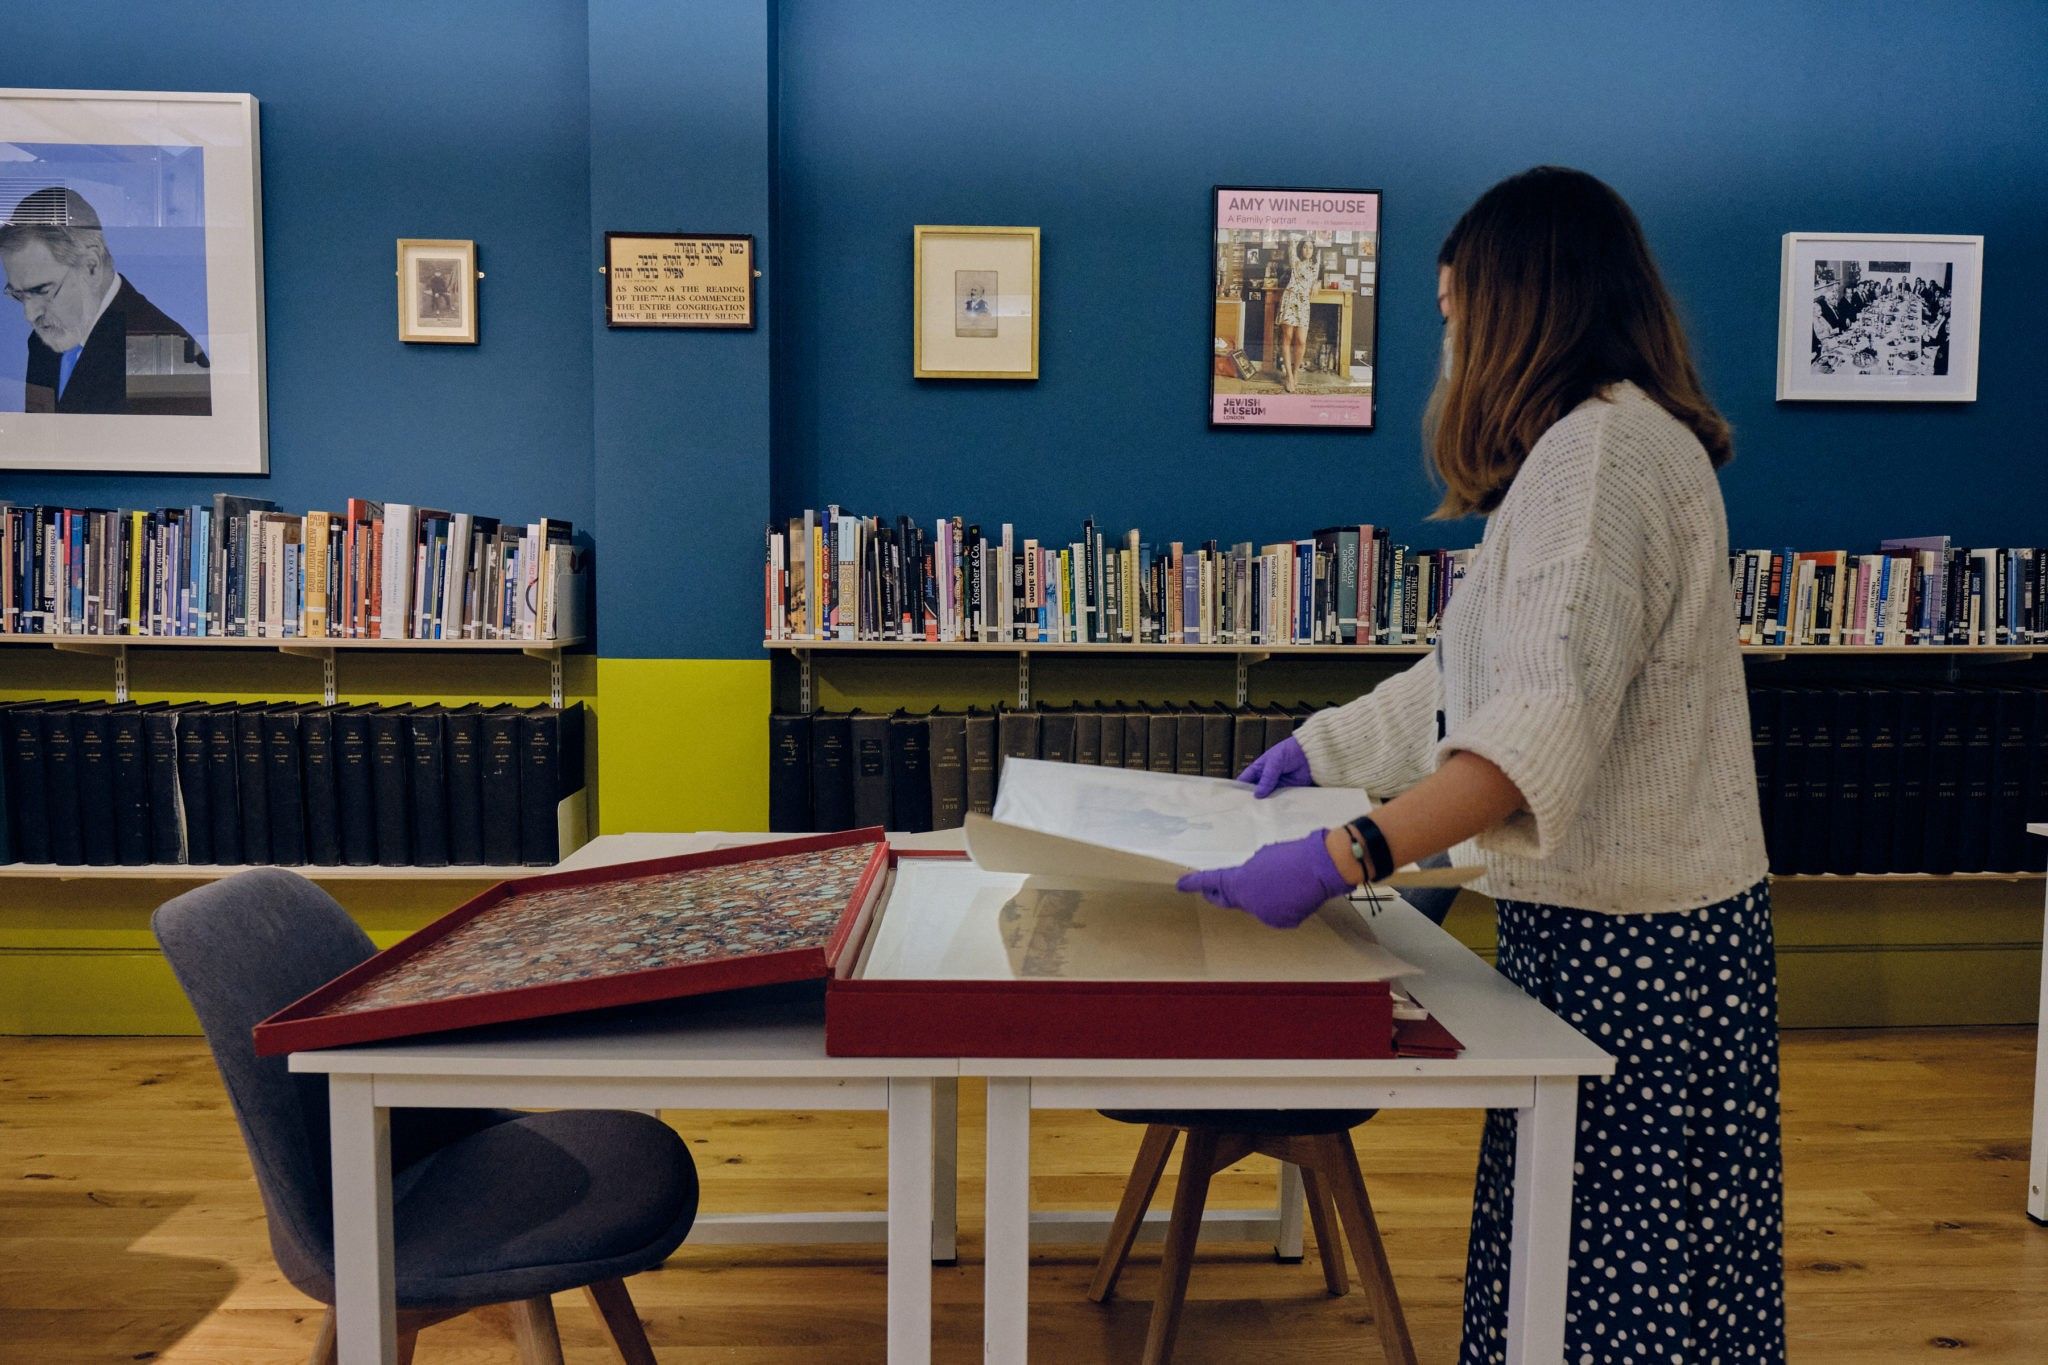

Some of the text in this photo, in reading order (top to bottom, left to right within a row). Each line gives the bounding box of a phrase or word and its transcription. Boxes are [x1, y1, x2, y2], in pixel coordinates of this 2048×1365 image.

[1229, 198, 1366, 213] AMY WINEHOUSE
[1236, 216, 1263, 225] Family
[1266, 216, 1297, 225] Portrait
[1224, 407, 1265, 415] MUSEUM
[972, 559, 979, 567] &
[1395, 550, 1403, 579] VOYAGE
[972, 568, 980, 604] Koscher
[1393, 589, 1402, 624] DAMNED
